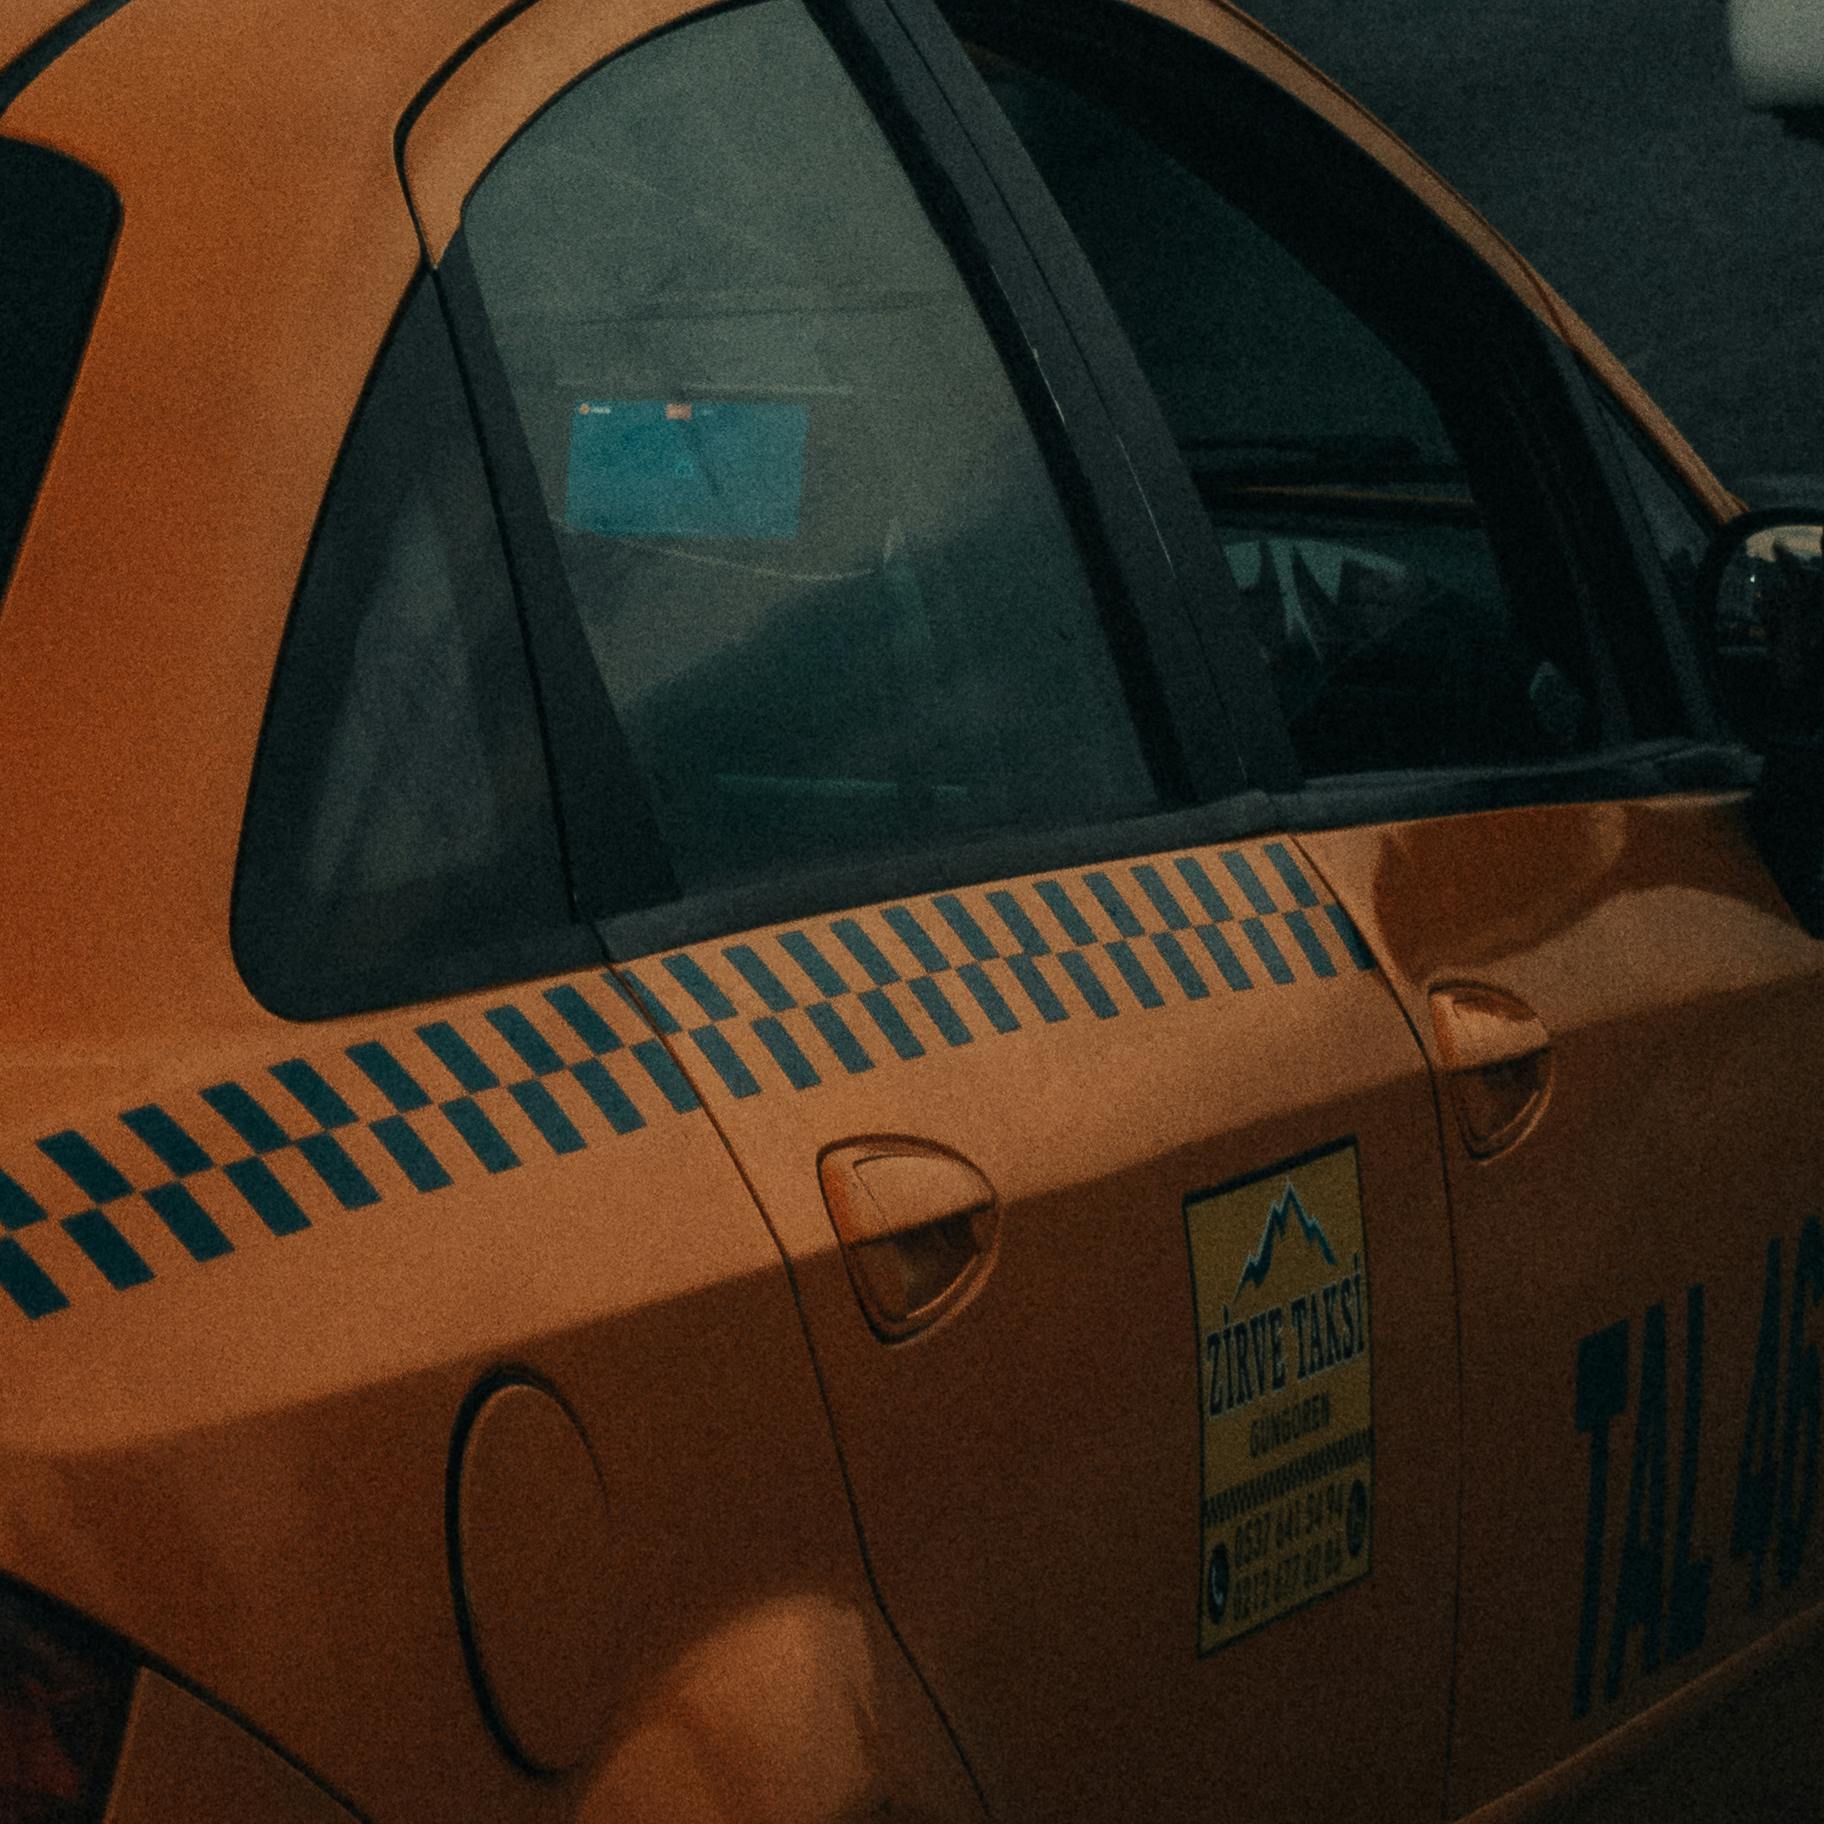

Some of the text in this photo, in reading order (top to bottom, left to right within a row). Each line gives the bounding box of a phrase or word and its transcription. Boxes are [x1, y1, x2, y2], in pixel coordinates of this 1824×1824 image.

[1205, 1252, 1366, 1416] ZİRVE TAKSİ
[1571, 1214, 1824, 1720] TAL 46
